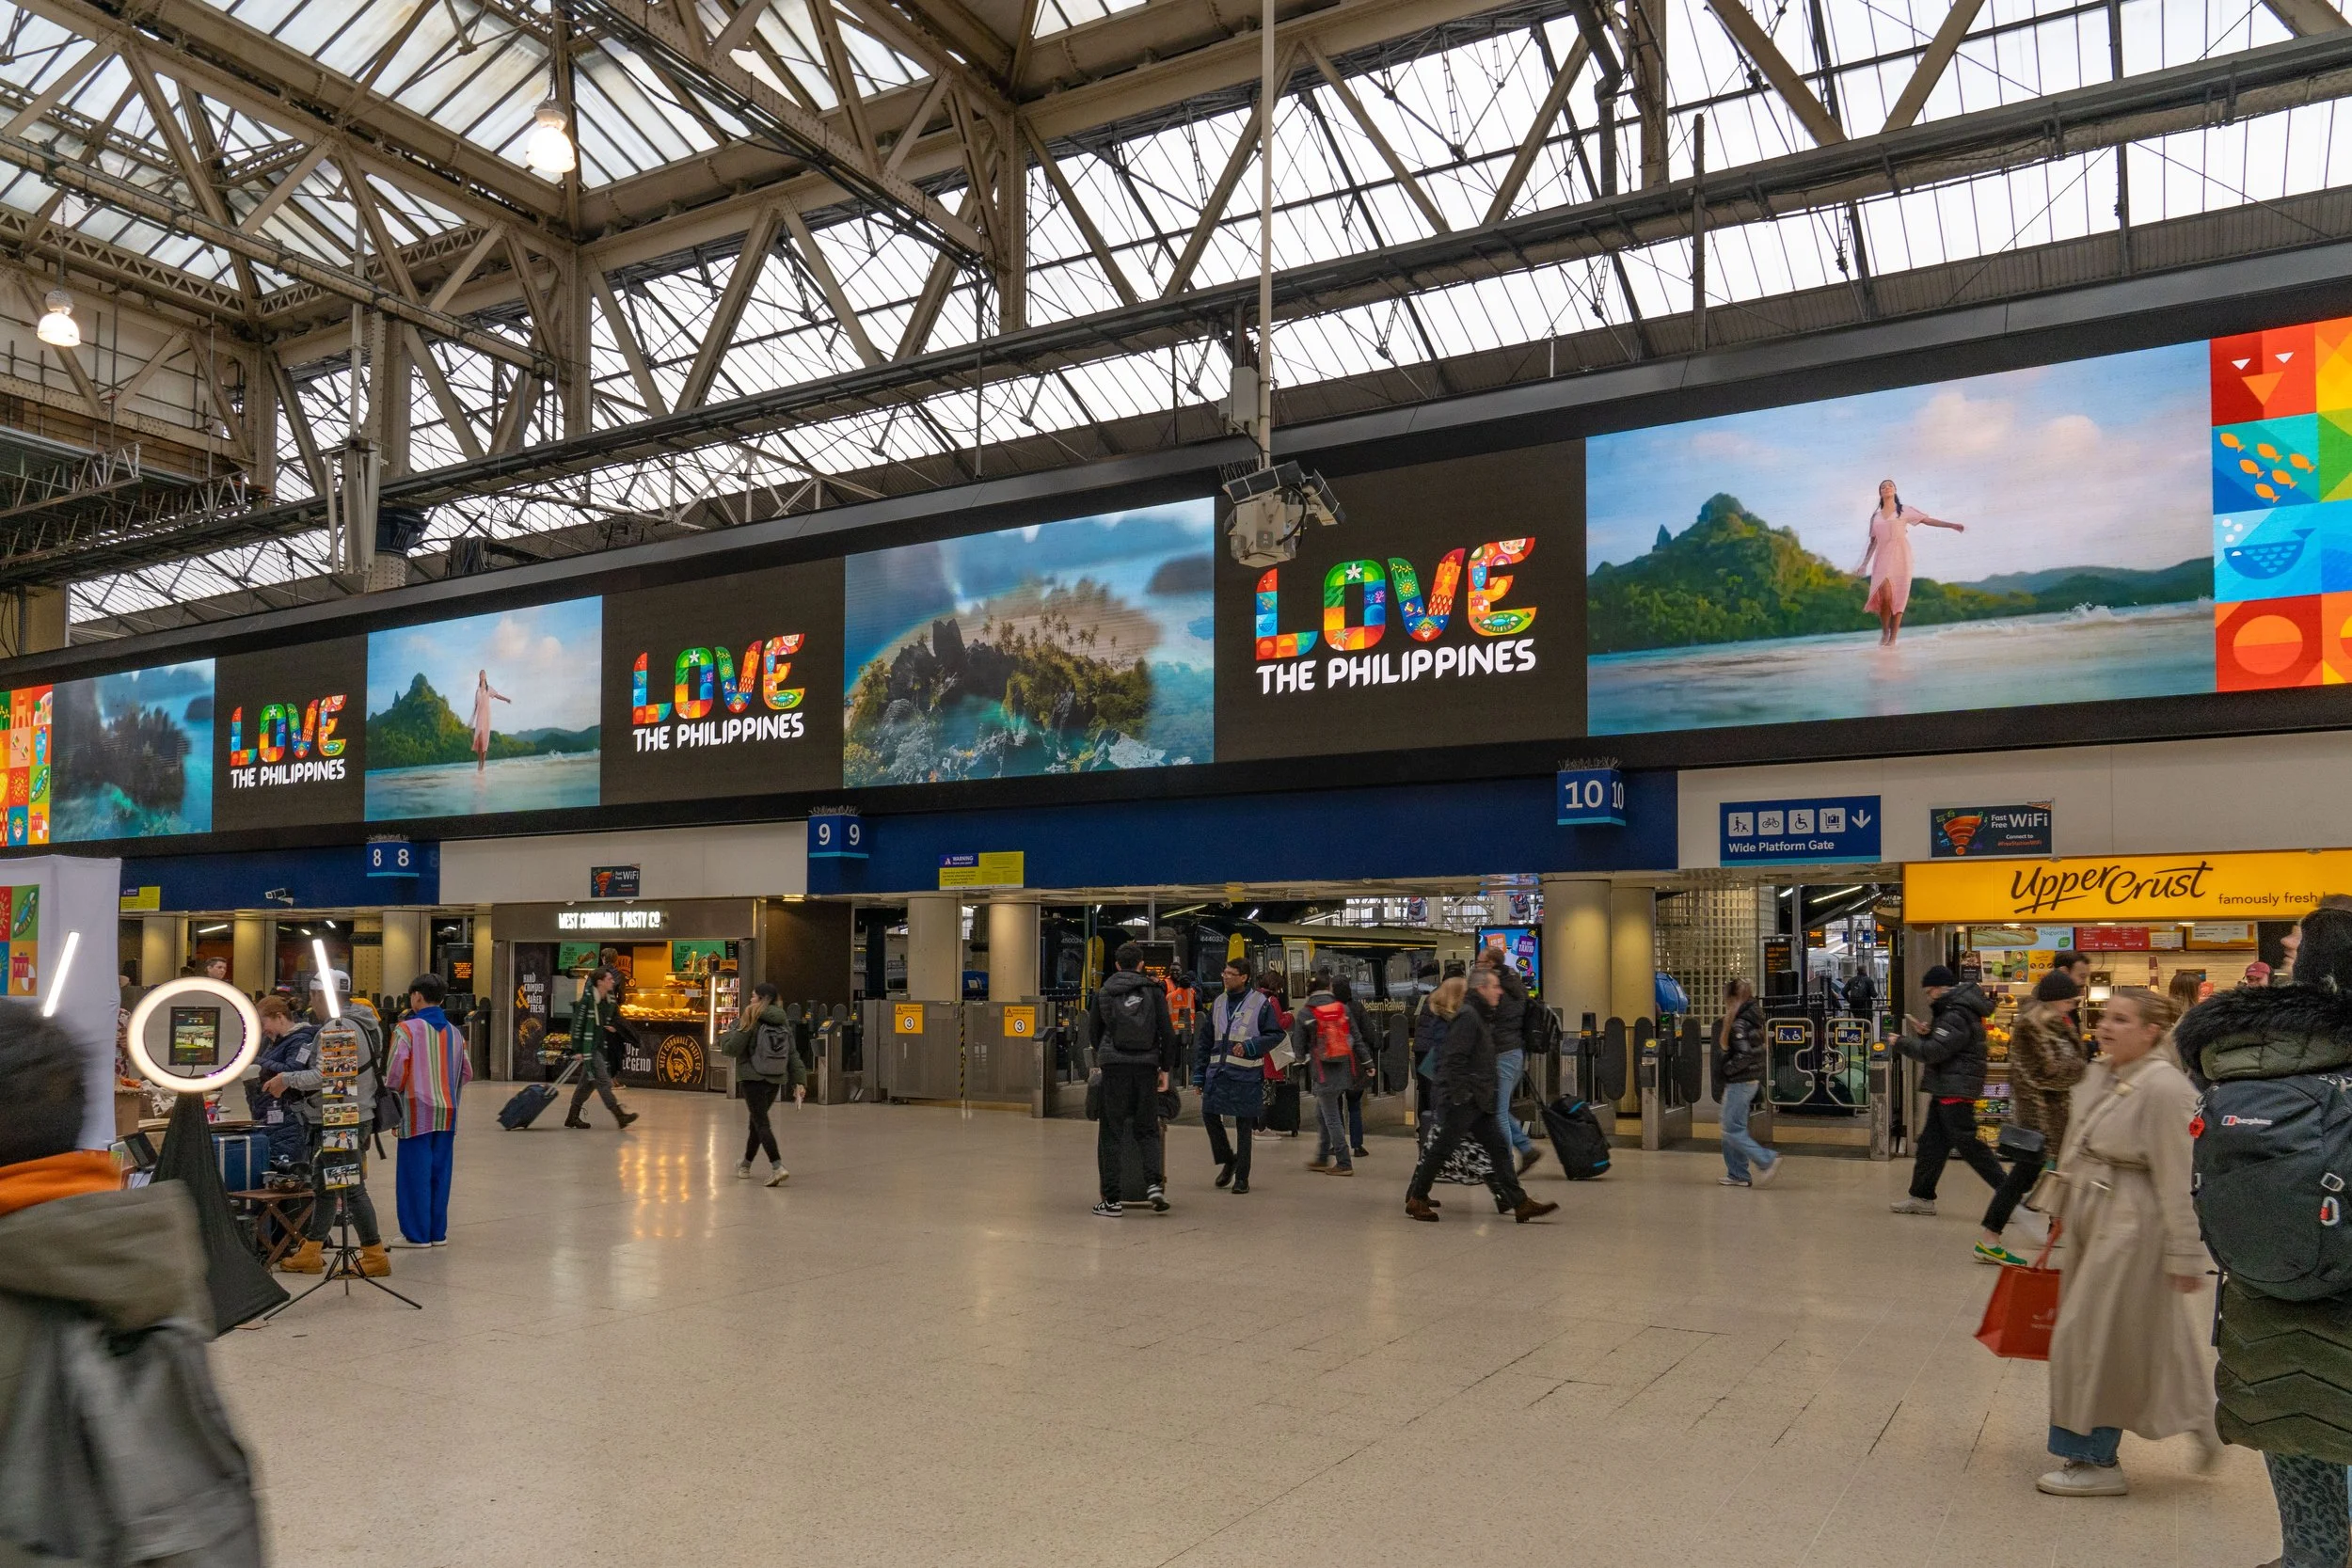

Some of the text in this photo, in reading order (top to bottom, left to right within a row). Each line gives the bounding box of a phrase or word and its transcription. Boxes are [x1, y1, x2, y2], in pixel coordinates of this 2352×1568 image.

[1255, 537, 1537, 660] LOVE
[1255, 639, 1536, 694] THE PHILIPPINES
[632, 633, 805, 724] LOVE
[230, 694, 347, 766] LOVE
[633, 712, 804, 752] THE PHILIPPINES
[230, 758, 345, 789] THE PHILIPPINES
[1565, 780, 1603, 808] 10
[1612, 782, 1624, 809] 10
[2009, 813, 2048, 827] WiFi
[818, 824, 831, 845] 9
[849, 824, 860, 845] 9
[1729, 840, 1834, 853] Wide Platform Gate
[373, 848, 381, 867] 8
[398, 848, 409, 867] 8
[623, 871, 639, 880] WiFi
[2011, 861, 2213, 913] Upper Crust
[2219, 893, 2279, 906] famously
[2284, 892, 2318, 903] fresh
[559, 913, 579, 929] WEST
[580, 912, 620, 928] CORNWALL
[622, 911, 647, 928] PASTY
[523, 972, 536, 983] HAND
[524, 984, 544, 993] CRIMPED
[530, 1004, 545, 1013] FRESH
